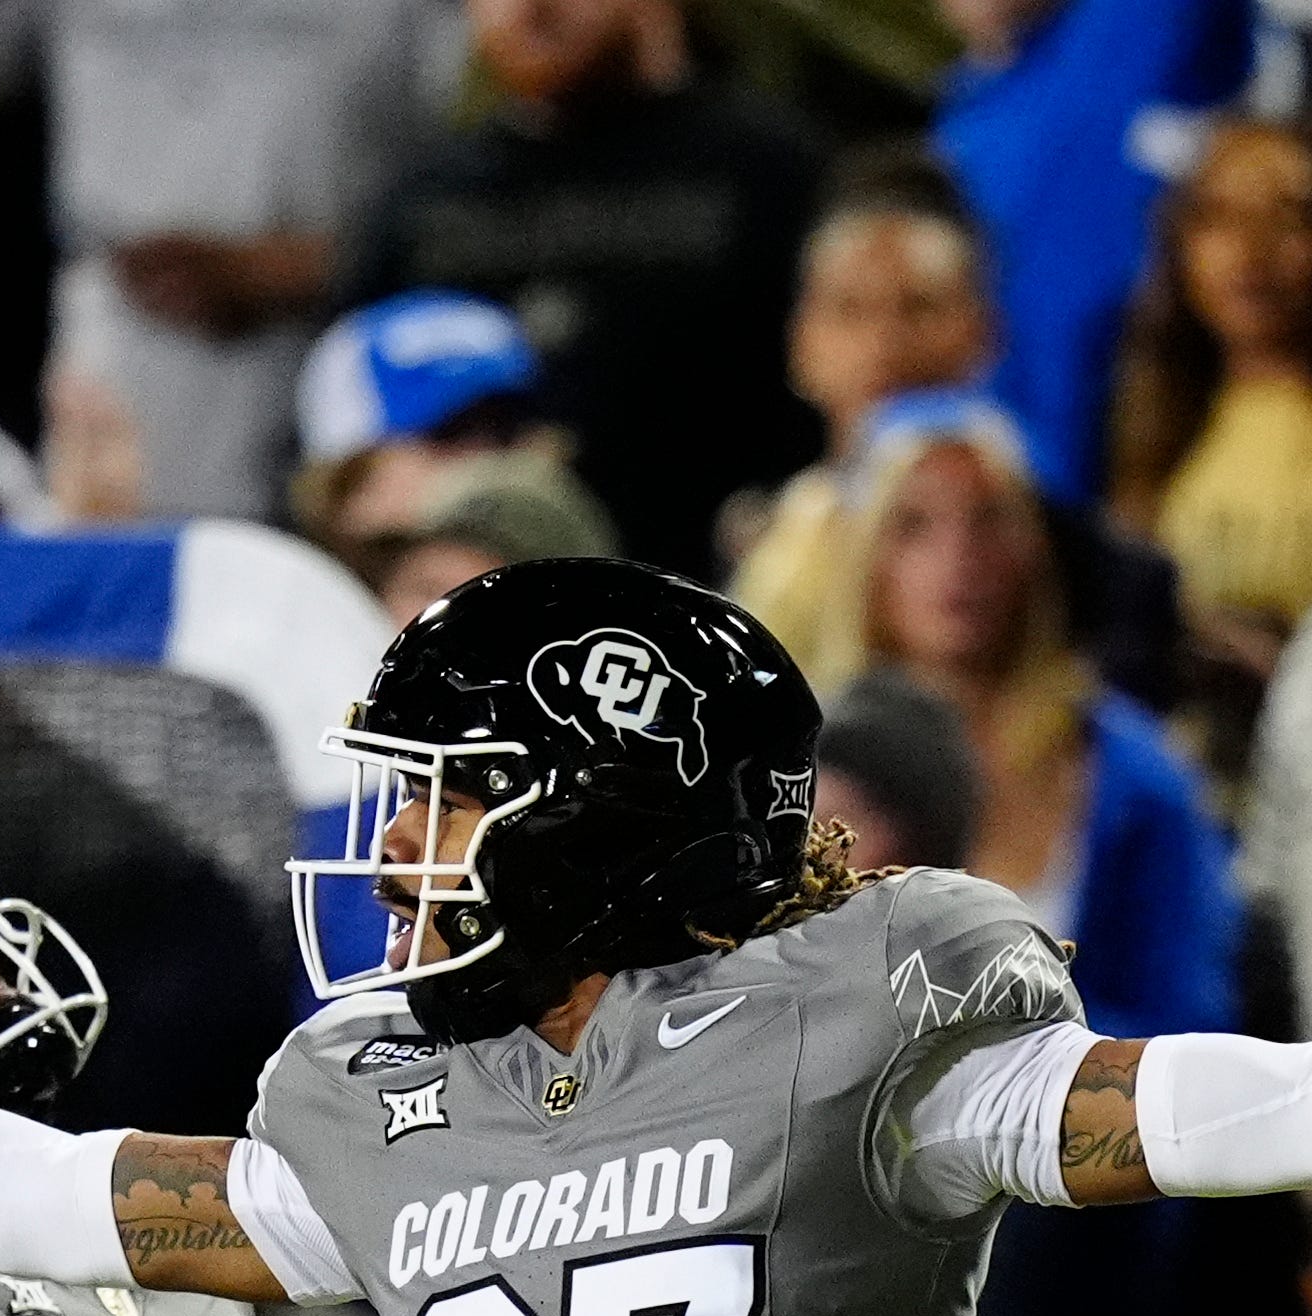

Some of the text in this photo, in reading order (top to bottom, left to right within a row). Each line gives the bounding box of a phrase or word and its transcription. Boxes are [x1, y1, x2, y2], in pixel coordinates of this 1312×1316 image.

[579, 639, 672, 730] CU
[767, 767, 813, 821] XII
[366, 1041, 433, 1060] mac
[380, 1074, 449, 1143] XII
[543, 1074, 582, 1115] CU
[388, 1138, 734, 1289] COLORADO
